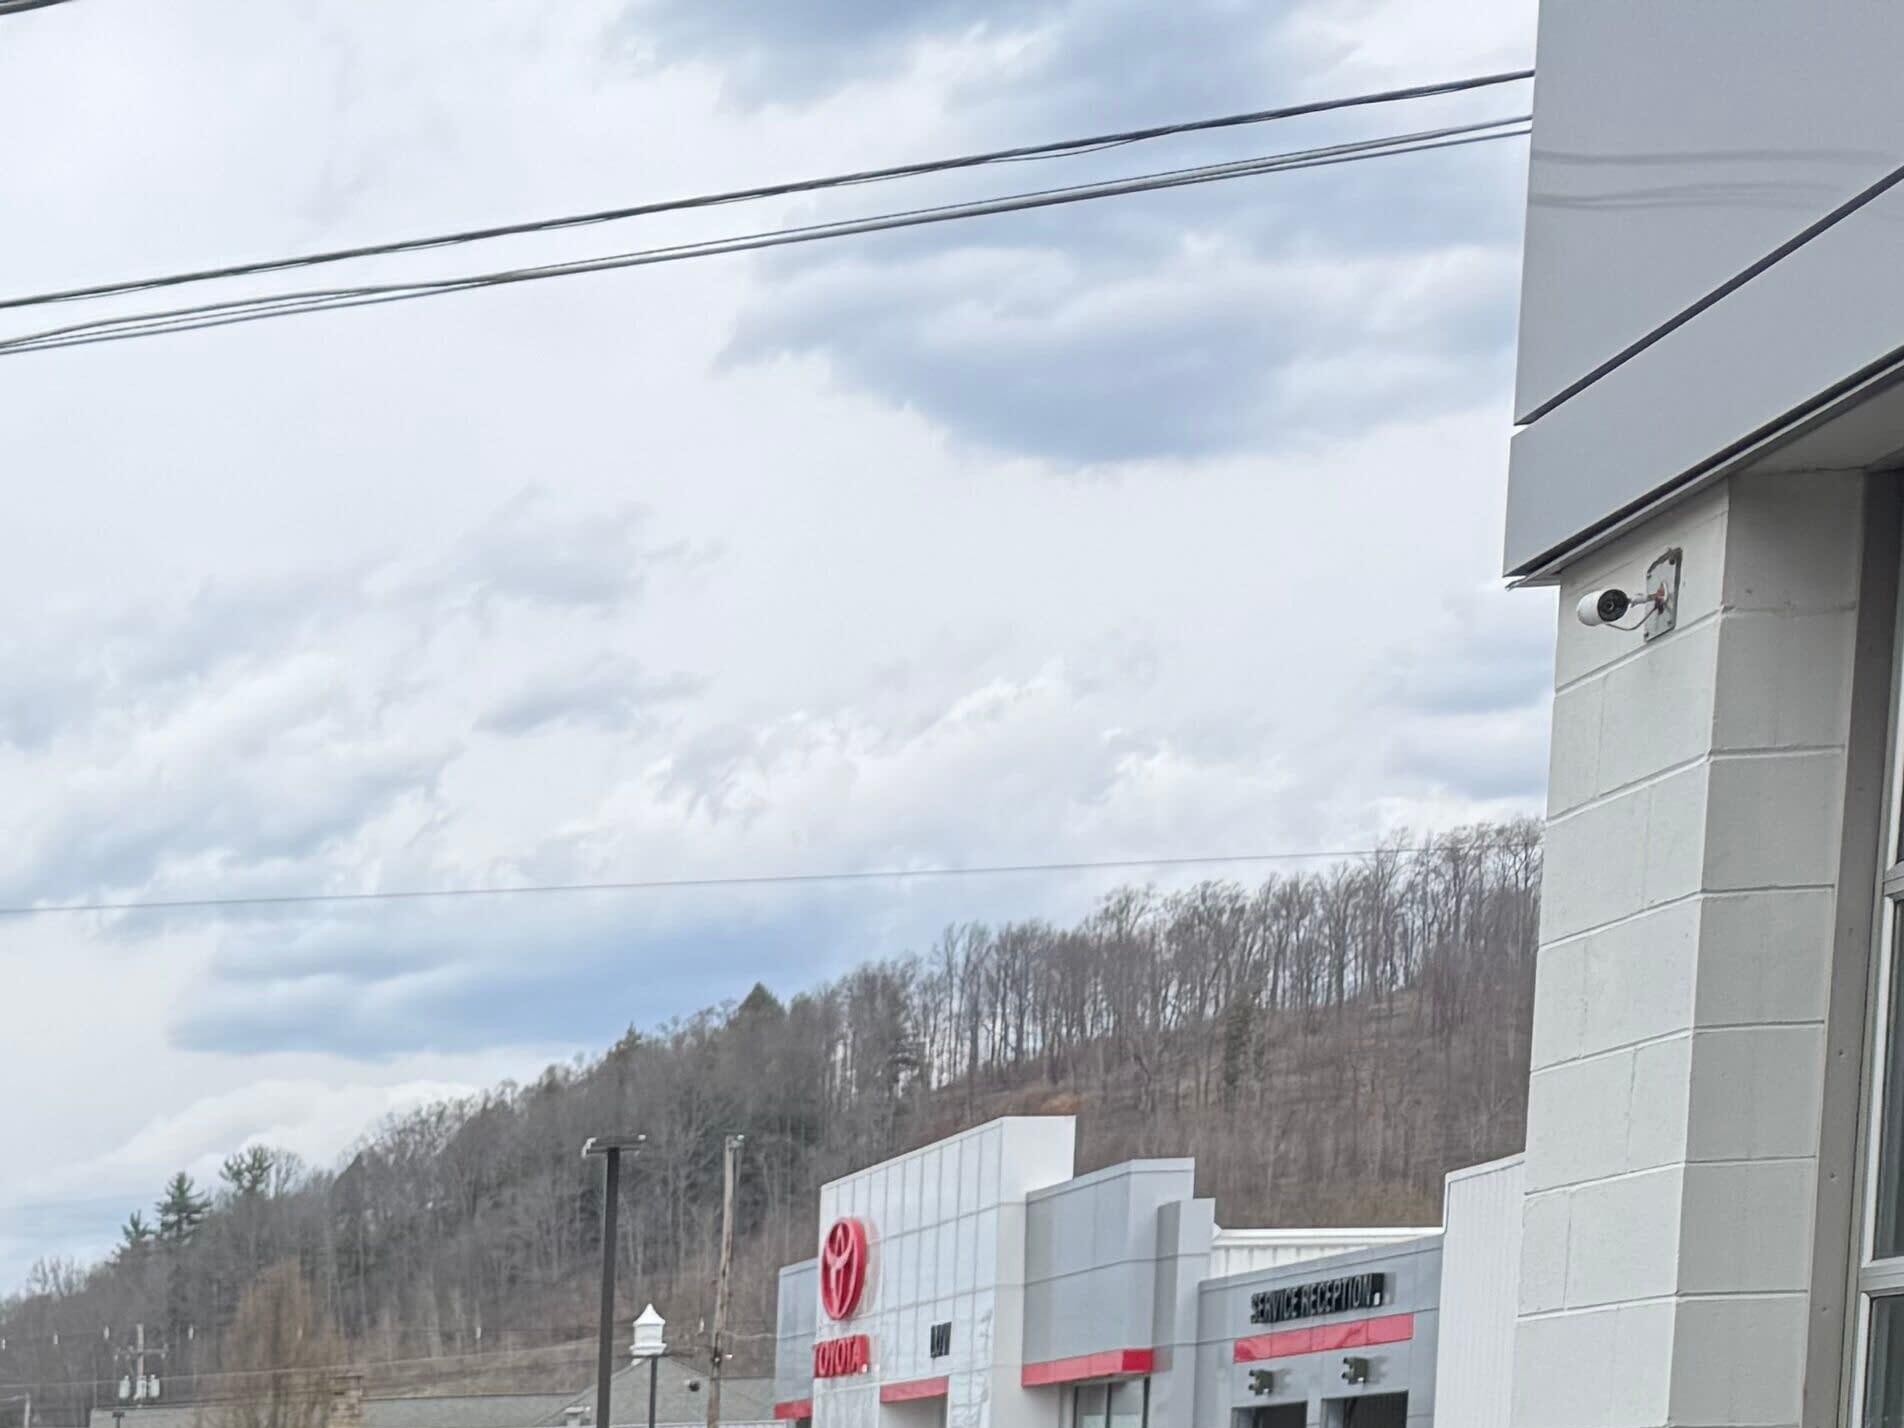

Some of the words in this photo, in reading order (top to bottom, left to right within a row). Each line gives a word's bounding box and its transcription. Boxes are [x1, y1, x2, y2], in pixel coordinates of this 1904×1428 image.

[1251, 1286, 1300, 1324] SERVICE
[1300, 1272, 1386, 1317] RECEPTION
[813, 1334, 870, 1378] TOYOTA
